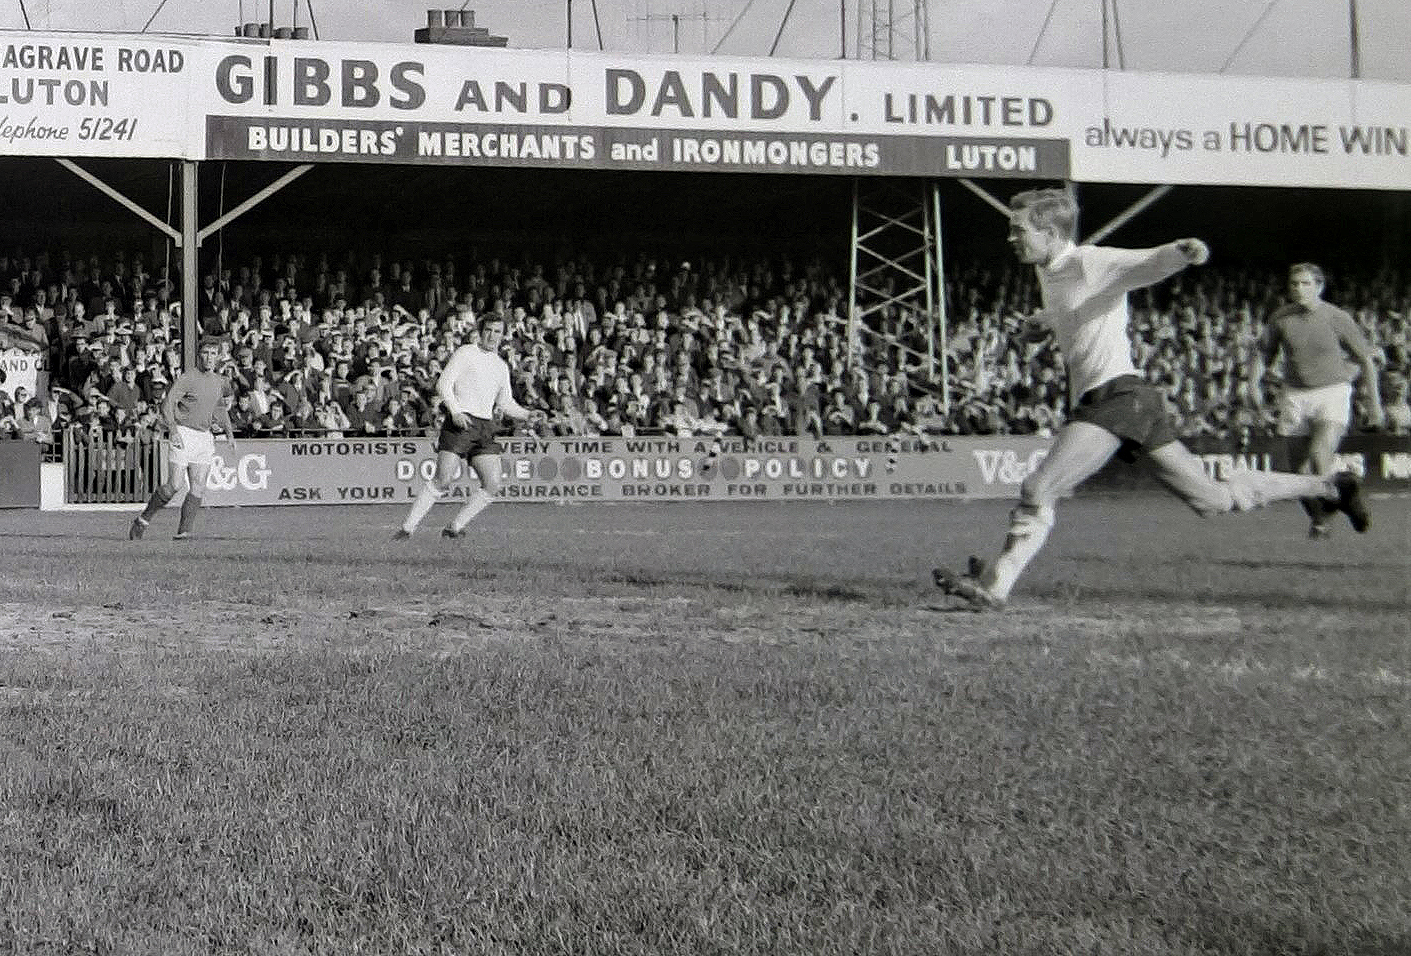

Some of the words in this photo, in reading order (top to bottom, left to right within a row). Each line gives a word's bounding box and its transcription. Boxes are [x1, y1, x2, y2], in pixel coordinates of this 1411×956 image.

[117, 48, 185, 74] ROAD
[215, 54, 427, 111] GIBBS
[455, 80, 572, 115] AND
[885, 93, 1054, 127] LIMITED
[417, 131, 596, 160] MERCHANTS
[610, 140, 658, 162] and
[673, 139, 880, 167] IRONMONGERS
[946, 144, 1037, 171] LUTON
[1085, 118, 1193, 158] always
[1203, 131, 1221, 151] a
[1230, 121, 1328, 154] HOME
[1339, 125, 1408, 156] WIN
[291, 442, 417, 455] MOTORISTS
[560, 441, 613, 453] TIME
[626, 441, 681, 453] WITH
[586, 458, 694, 480] BONUS
[744, 457, 870, 479] POLICY
[278, 487, 322, 500] ASK
[338, 486, 395, 500] YOUR
[495, 484, 602, 498] NSURANCE
[622, 483, 711, 496] BROKER
[727, 483, 767, 496] FOR
[783, 482, 877, 496] FURTHER
